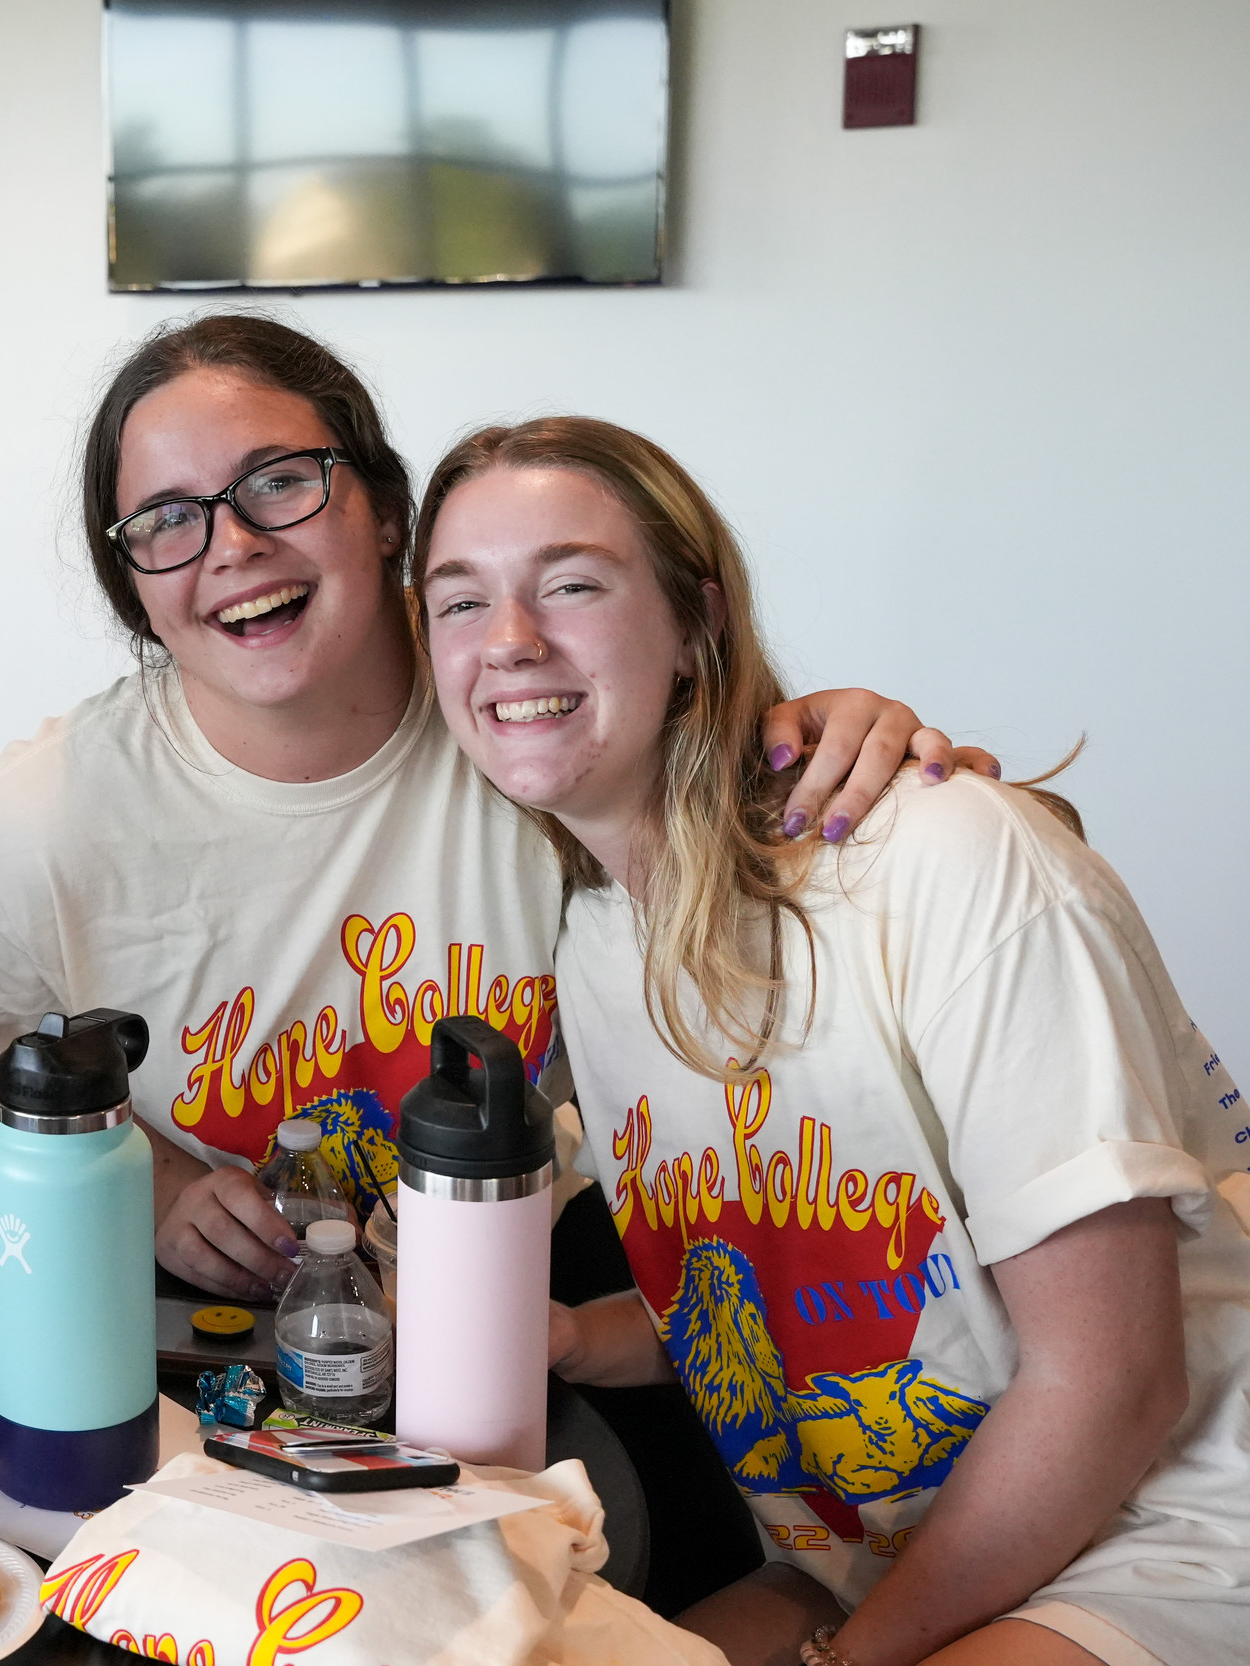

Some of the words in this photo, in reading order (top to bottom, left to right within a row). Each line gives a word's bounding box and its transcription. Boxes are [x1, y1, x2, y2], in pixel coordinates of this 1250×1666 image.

[171, 986, 347, 1127] Hope
[341, 912, 557, 1059] College
[609, 1094, 726, 1246] Hope
[725, 1056, 947, 1270] College
